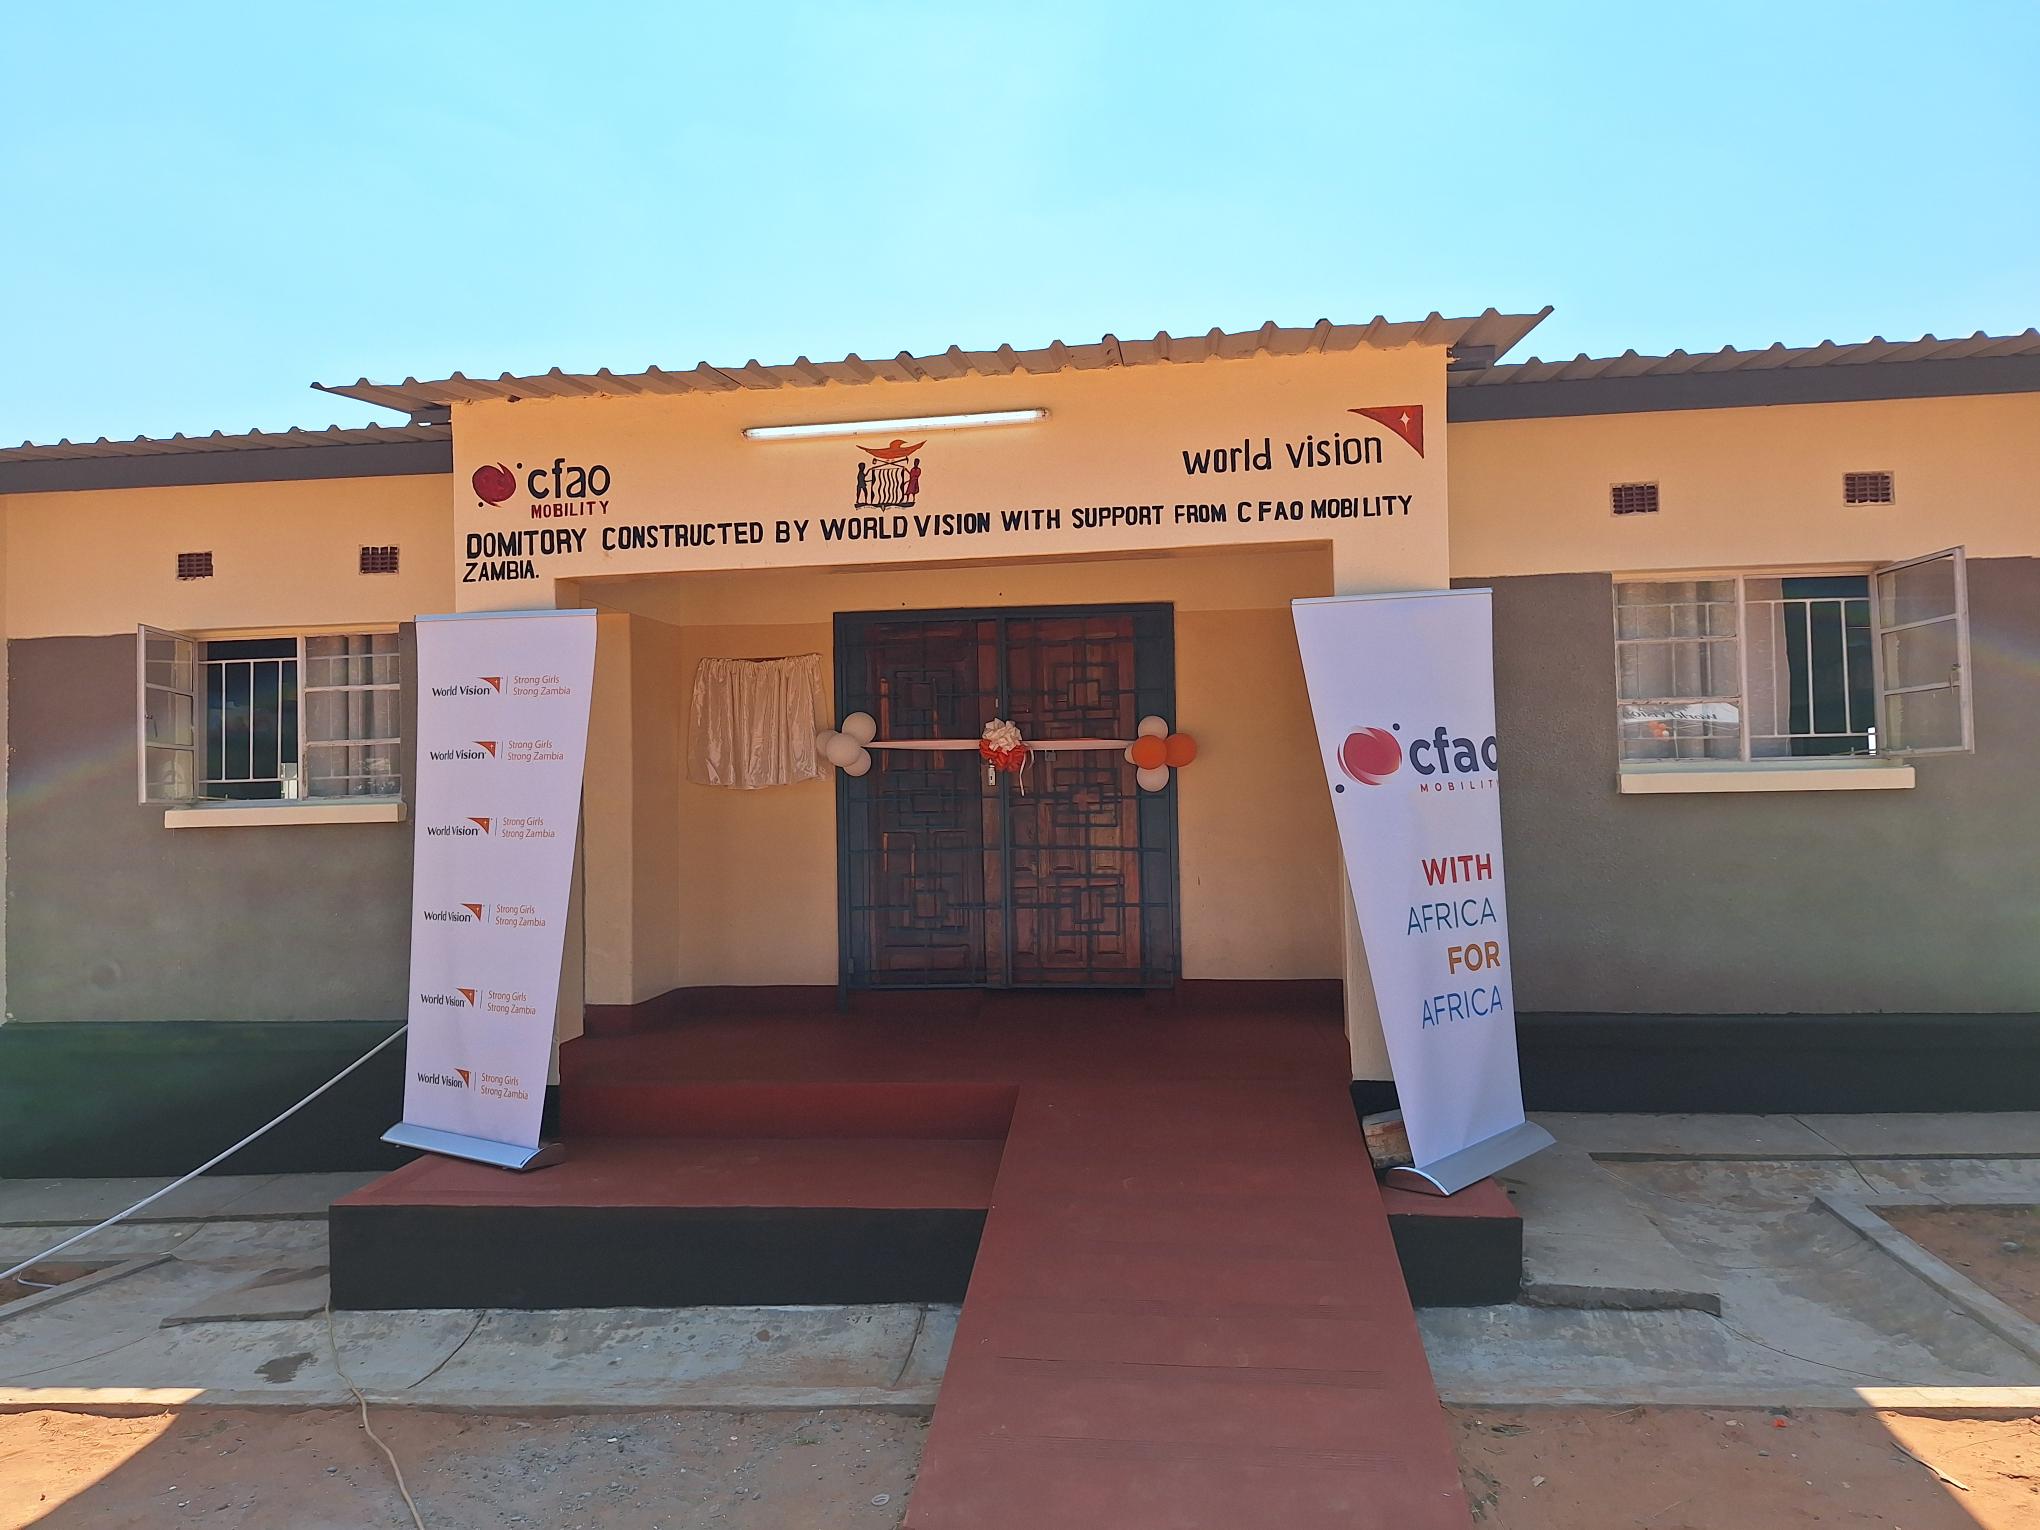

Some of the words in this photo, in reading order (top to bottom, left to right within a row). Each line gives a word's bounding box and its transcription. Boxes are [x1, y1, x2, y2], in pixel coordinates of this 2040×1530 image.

[1183, 438, 1272, 475] world
[1286, 432, 1383, 469] vision
[528, 458, 611, 499] cfao
[531, 501, 609, 519] MOBILITY
[466, 528, 587, 559] DOMITORY
[602, 521, 763, 551] CONSTRUCTED
[775, 520, 809, 543] BY
[820, 516, 908, 541] WORLD
[914, 511, 990, 538] VISION
[1001, 509, 1060, 532] WITH
[1072, 504, 1164, 529] SUPPORT
[1174, 503, 1227, 524] FROM
[1311, 494, 1413, 519] MOBILITY
[463, 560, 540, 582] ZAMBIA.
[514, 676, 540, 685] Strong
[542, 675, 559, 683] Girls
[432, 686, 457, 696] World
[459, 685, 490, 696] Vision
[513, 688, 538, 697] Strong
[541, 687, 571, 695] Zambia
[509, 740, 533, 750] Strong
[535, 740, 552, 748] Girls
[1409, 727, 1498, 775] cfao
[430, 750, 453, 760] World
[456, 749, 485, 759] Vision
[508, 753, 532, 762] Strong
[533, 752, 563, 760] Zambia
[503, 817, 525, 826] Strong
[527, 817, 544, 825] Girls
[428, 826, 450, 836] World
[452, 826, 478, 835] Vision
[502, 830, 524, 839] Strong
[526, 830, 555, 838] Zambia
[1421, 854, 1492, 886] WITH
[496, 904, 518, 915] Strong
[520, 905, 535, 913] Girls
[424, 911, 447, 921] World
[449, 912, 471, 922] Vision
[496, 915, 518, 927] Strong
[519, 917, 545, 926] Zambia
[1407, 897, 1497, 935] AFRICA
[1448, 941, 1500, 974] FOR
[421, 994, 444, 1004] World
[445, 996, 465, 1007] Vision
[489, 991, 511, 1001] Strong
[512, 992, 527, 1001] Girls
[488, 1003, 510, 1015] Strong
[511, 1006, 536, 1015] Zambia
[1422, 985, 1503, 1029] AFRICA
[418, 1072, 440, 1084] World
[441, 1075, 463, 1088] Vision
[481, 1073, 503, 1085] Strong
[504, 1076, 519, 1086] Girls
[481, 1086, 502, 1098] Strong
[503, 1089, 528, 1100] Zambia
